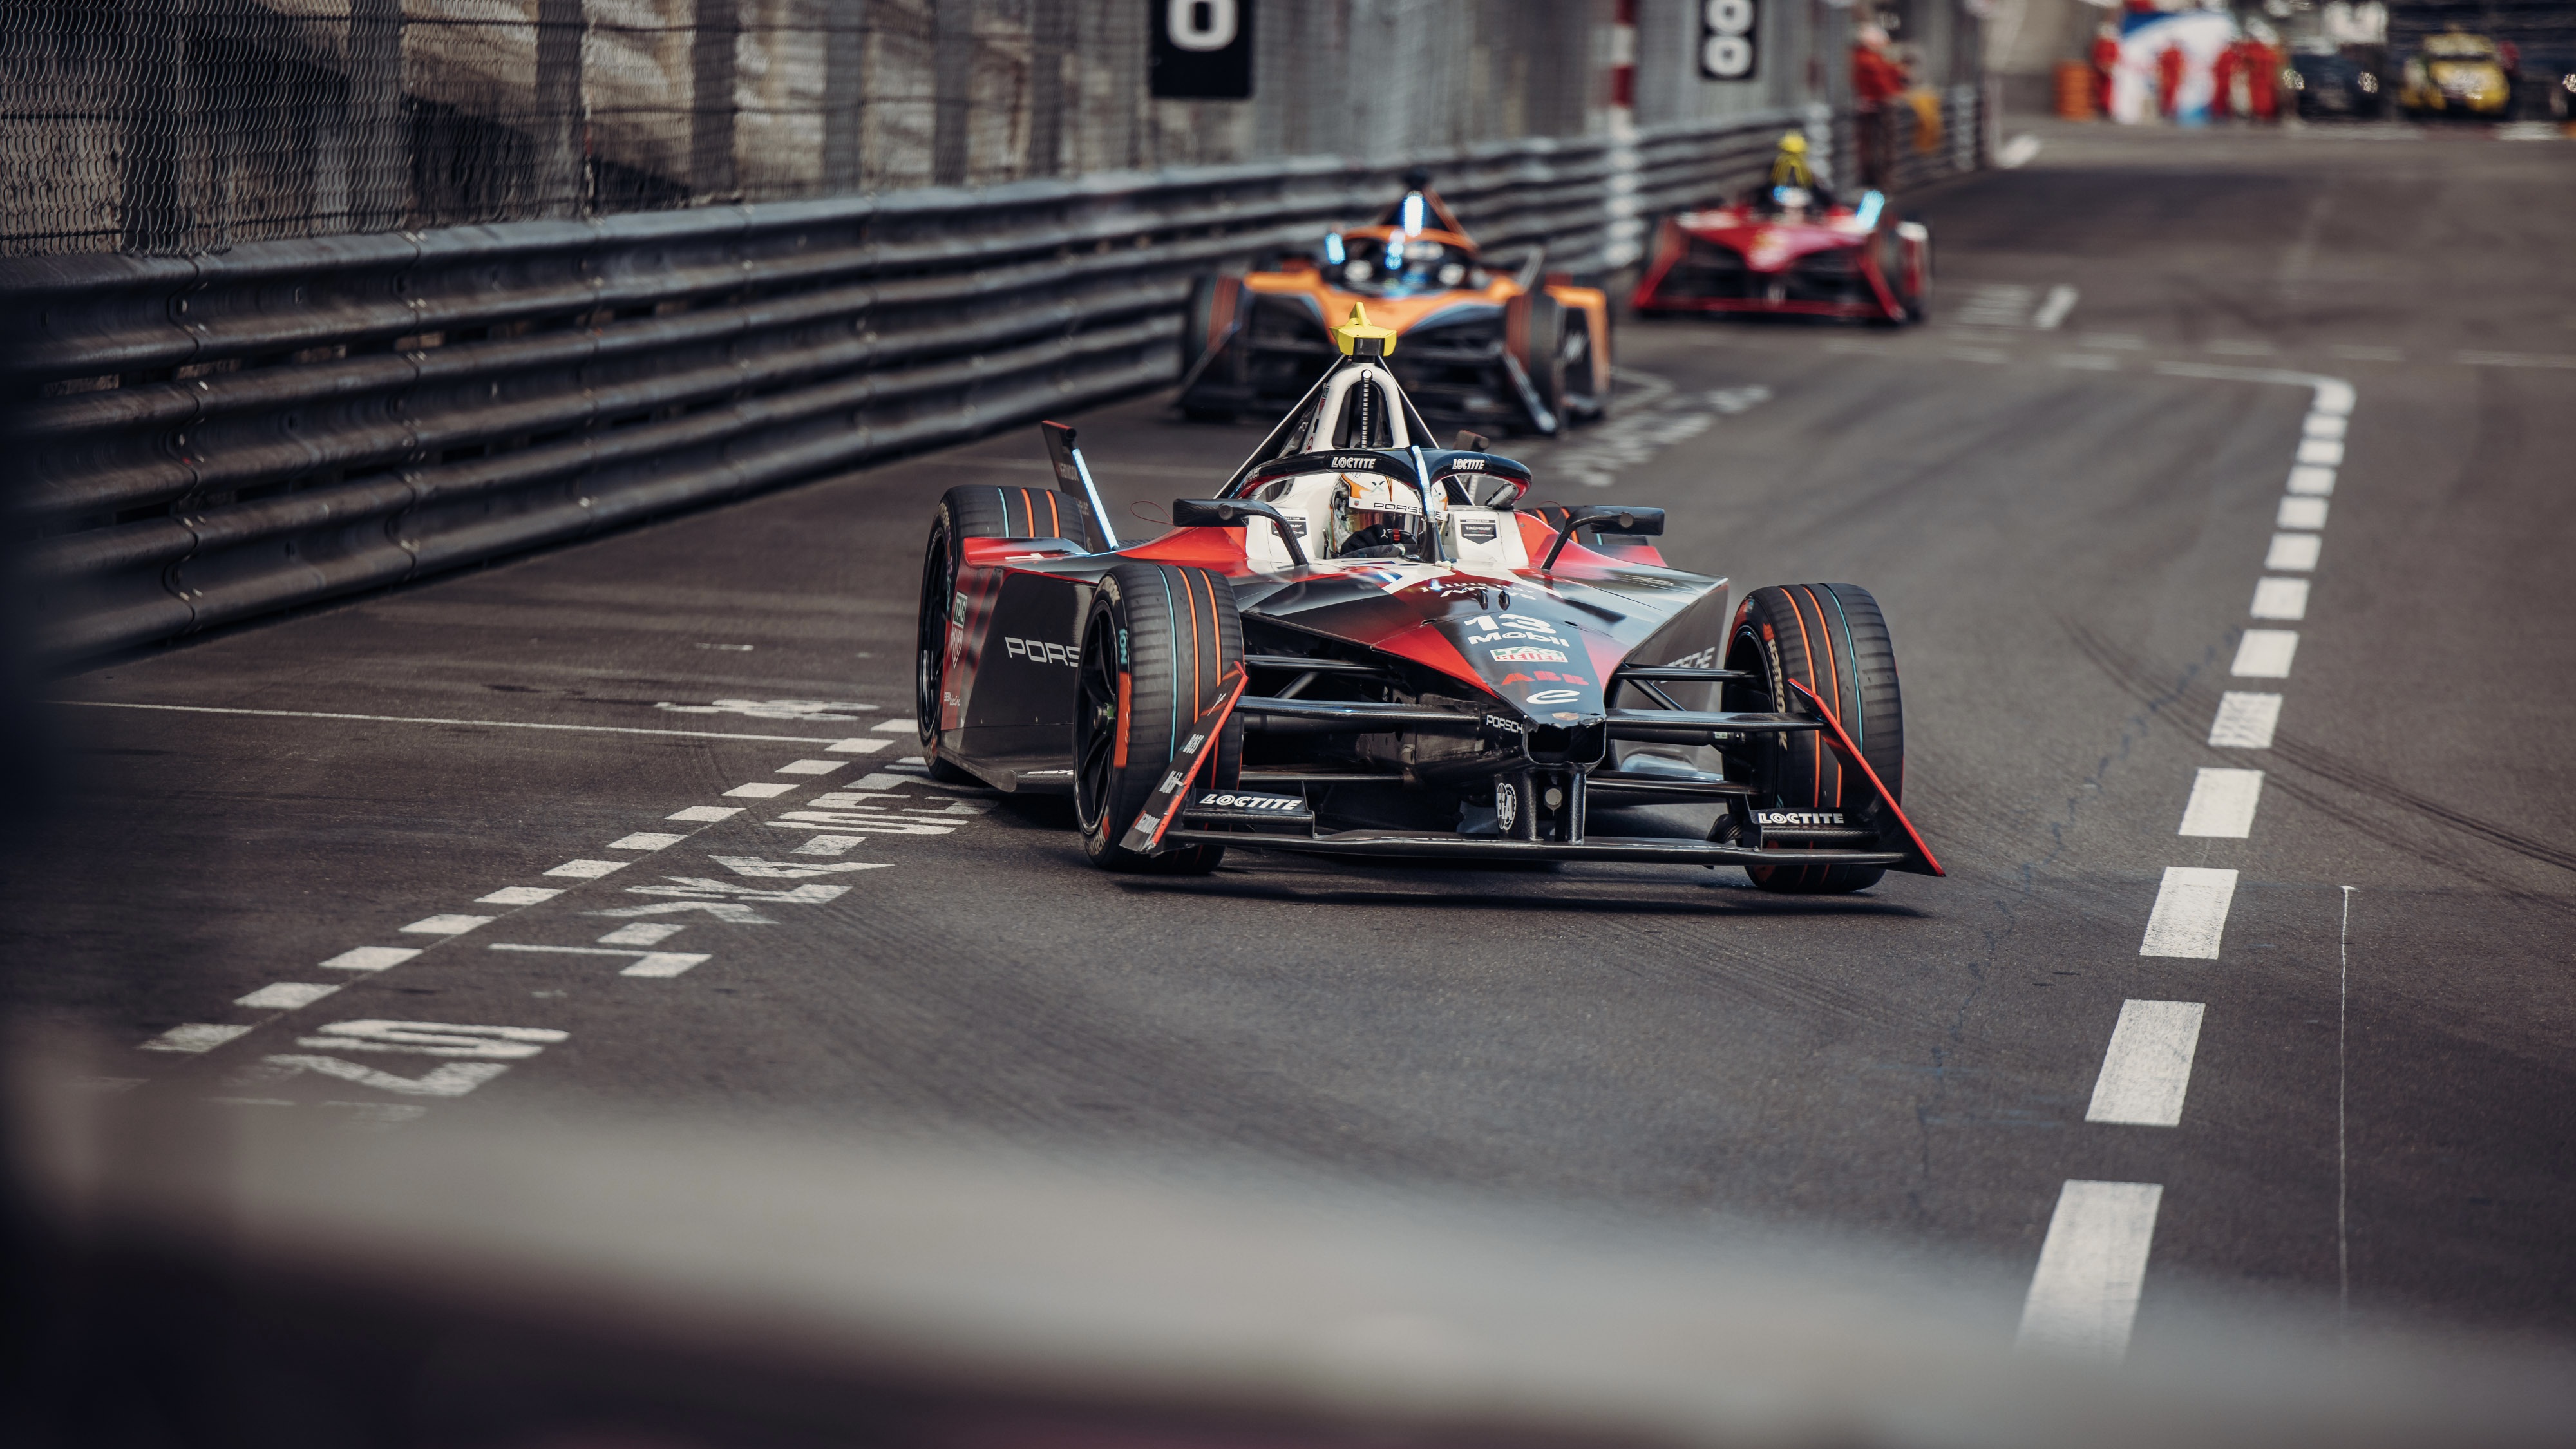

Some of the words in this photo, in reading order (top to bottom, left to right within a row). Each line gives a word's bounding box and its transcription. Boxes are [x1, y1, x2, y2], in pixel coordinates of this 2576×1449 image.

[1331, 457, 1376, 469] LOCTITE
[1452, 458, 1485, 471] LOCTITE
[1374, 502, 1441, 518] PORSCE
[955, 598, 966, 622] TAG
[1464, 614, 1557, 634] 13
[1468, 632, 1570, 647] Mobil
[1005, 636, 1081, 668] PORS
[1495, 647, 1562, 656] TAG
[1497, 652, 1566, 661] HEUER
[1501, 670, 1589, 686] ABB
[1486, 714, 1524, 734] PORSCH
[1183, 734, 1204, 754] BOSS
[1198, 793, 1303, 811] LOCTITE
[1758, 812, 1845, 825] LOCTITE
